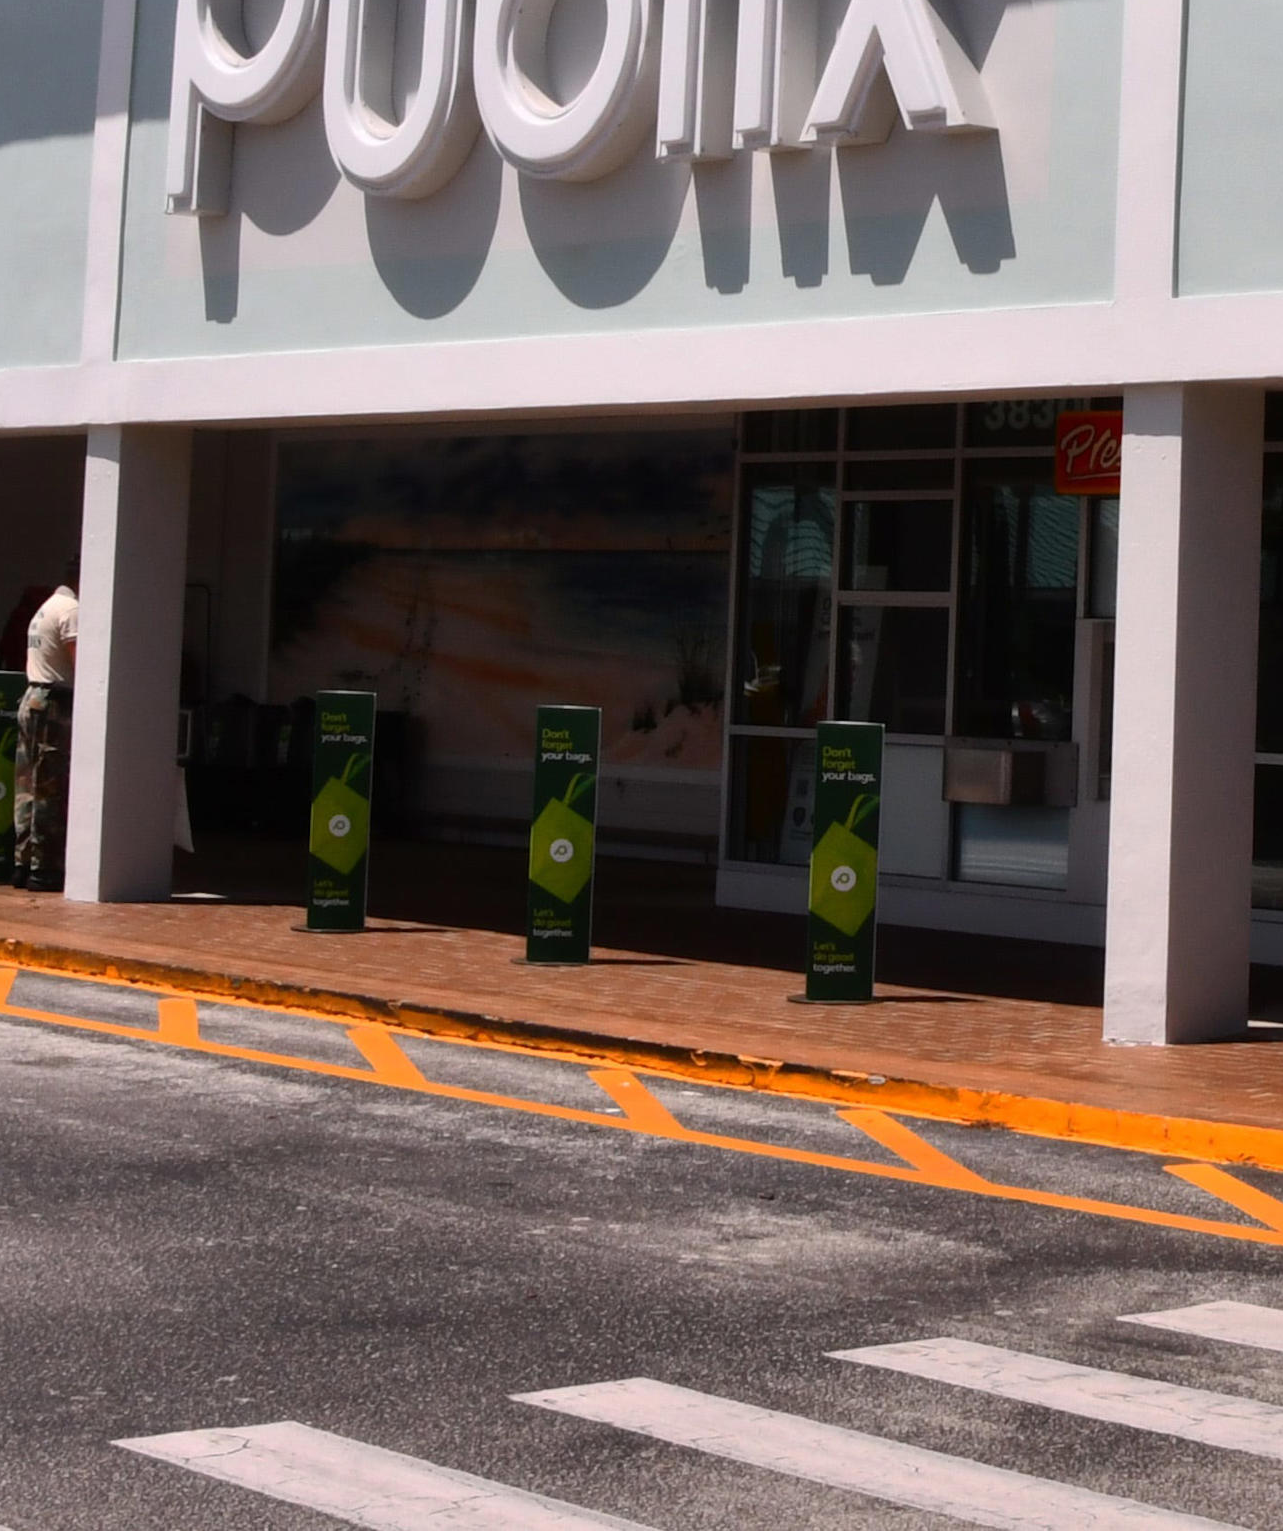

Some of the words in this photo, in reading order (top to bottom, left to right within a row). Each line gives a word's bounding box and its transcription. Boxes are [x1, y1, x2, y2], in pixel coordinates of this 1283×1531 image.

[1061, 424, 1122, 474] Pre
[822, 746, 852, 757] Don't
[822, 757, 856, 772] forget
[821, 771, 845, 783] your
